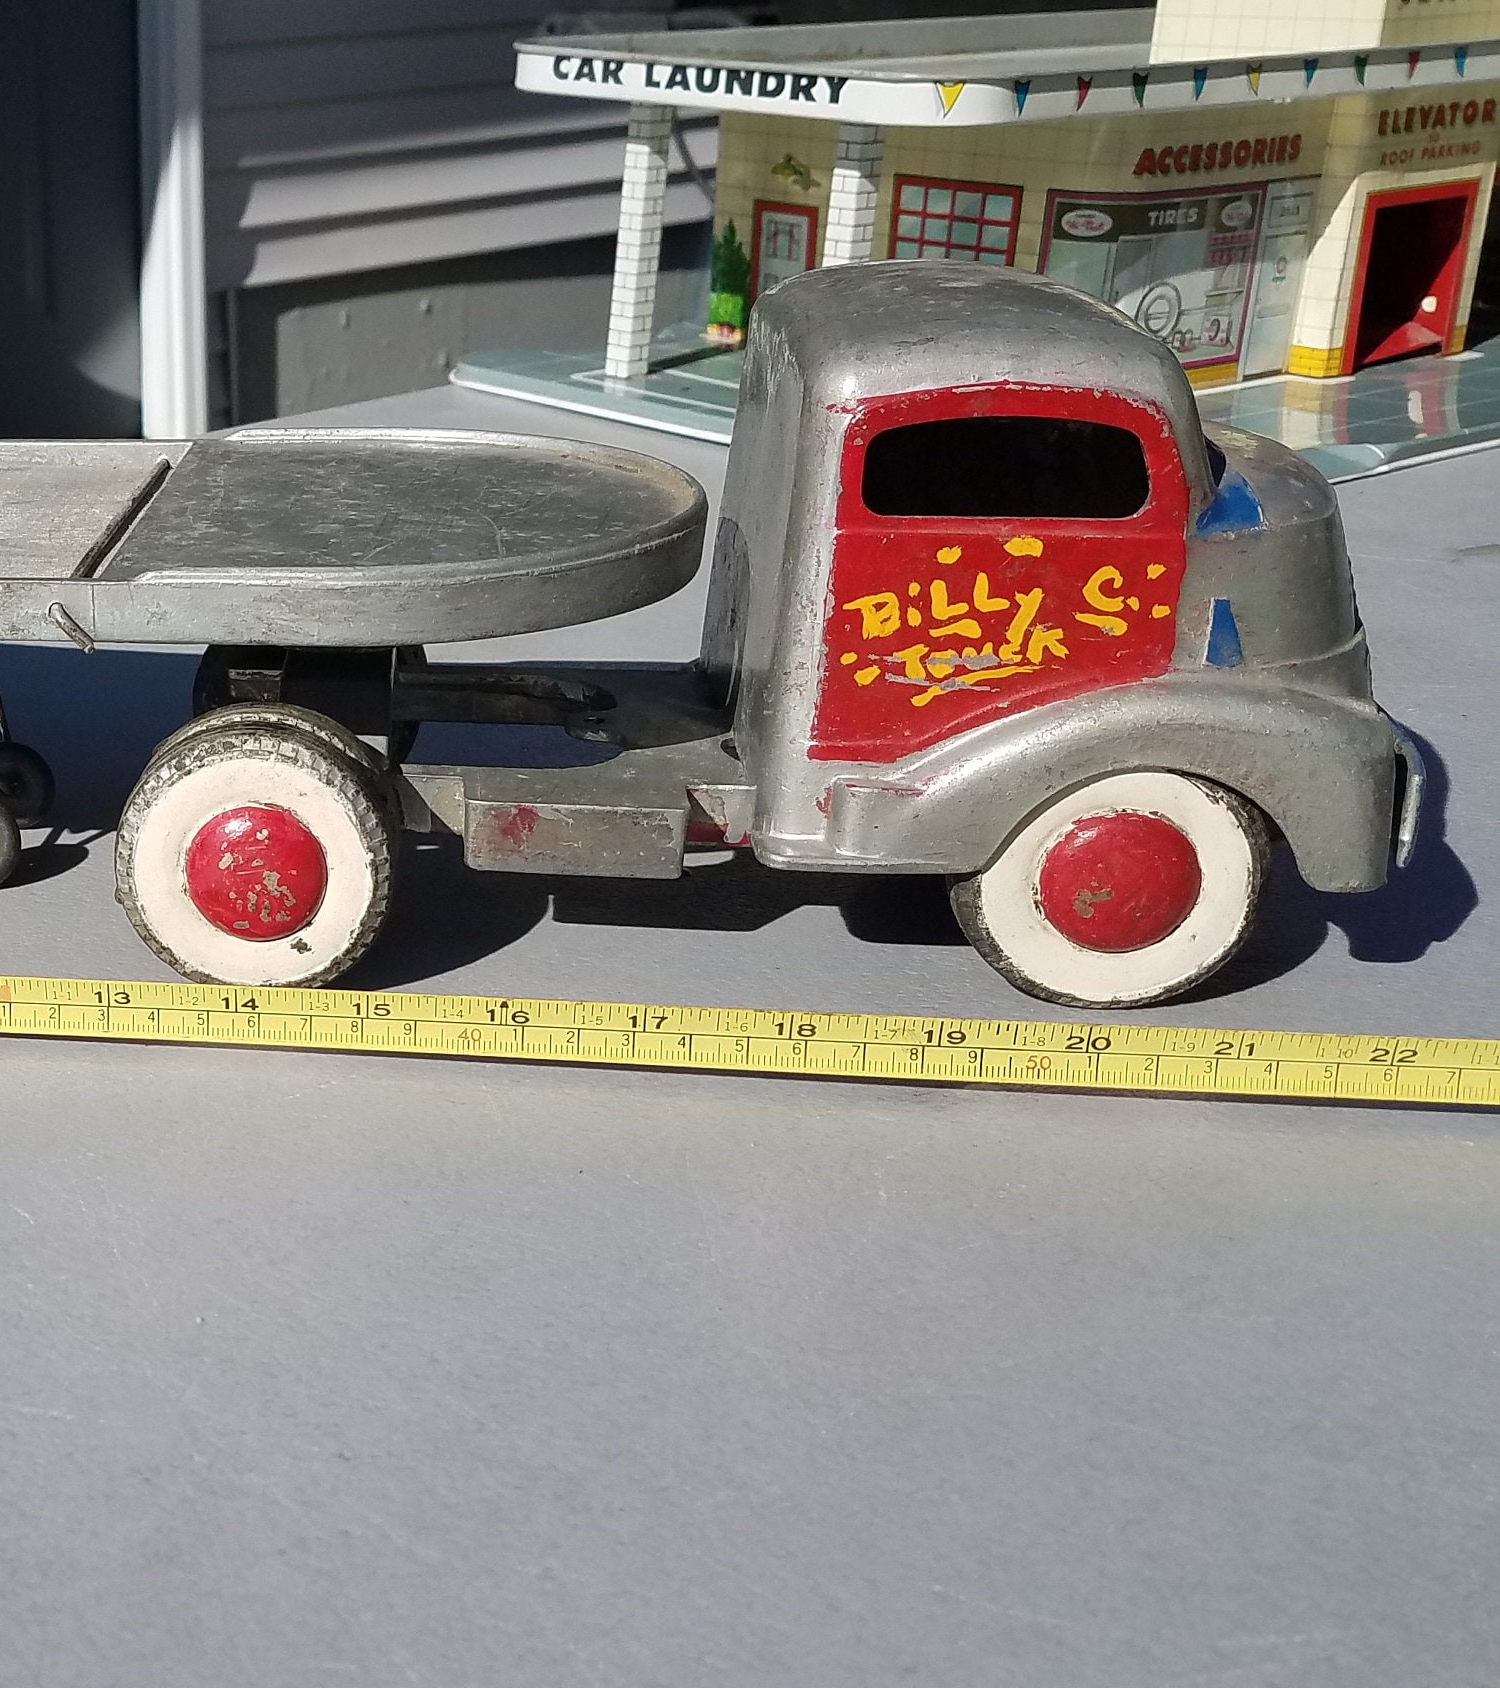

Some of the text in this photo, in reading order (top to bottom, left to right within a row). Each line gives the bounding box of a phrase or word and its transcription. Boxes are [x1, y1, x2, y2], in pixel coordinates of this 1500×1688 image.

[553, 55, 849, 105] CAR LAUNDRY
[1378, 98, 1496, 136] ELEVATOR
[1132, 134, 1302, 176] ACCESSORIES
[1421, 139, 1482, 160] PARKING
[1148, 207, 1199, 227] TIRES
[1, 1006, 7, 1017] 1
[49, 1007, 56, 1019] 2
[98, 1009, 105, 1021] 3
[148, 1011, 155, 1023] 4
[197, 1013, 204, 1025] 5
[248, 1015, 255, 1028] 6
[300, 1018, 307, 1030] 7
[351, 1021, 358, 1033] 8
[404, 1023, 412, 1035] 9
[458, 1028, 481, 1041] 40
[512, 1029, 517, 1040] 1
[566, 1031, 574, 1044] 2
[621, 1034, 629, 1046] 3
[678, 1036, 686, 1048] 4
[735, 1039, 743, 1052] 5
[792, 1042, 801, 1055] 6
[852, 1046, 860, 1058] 7
[910, 1048, 918, 1061] 8
[968, 1050, 977, 1063] 9
[1026, 1056, 1051, 1070] 50
[1088, 1055, 1093, 1068] 1
[1144, 1057, 1153, 1070] 2
[1204, 1060, 1212, 1073] 3
[1264, 1062, 1272, 1075] 4
[1324, 1066, 1333, 1079] 5
[1384, 1068, 1393, 1081] 6
[1446, 1071, 1455, 1084] 7
